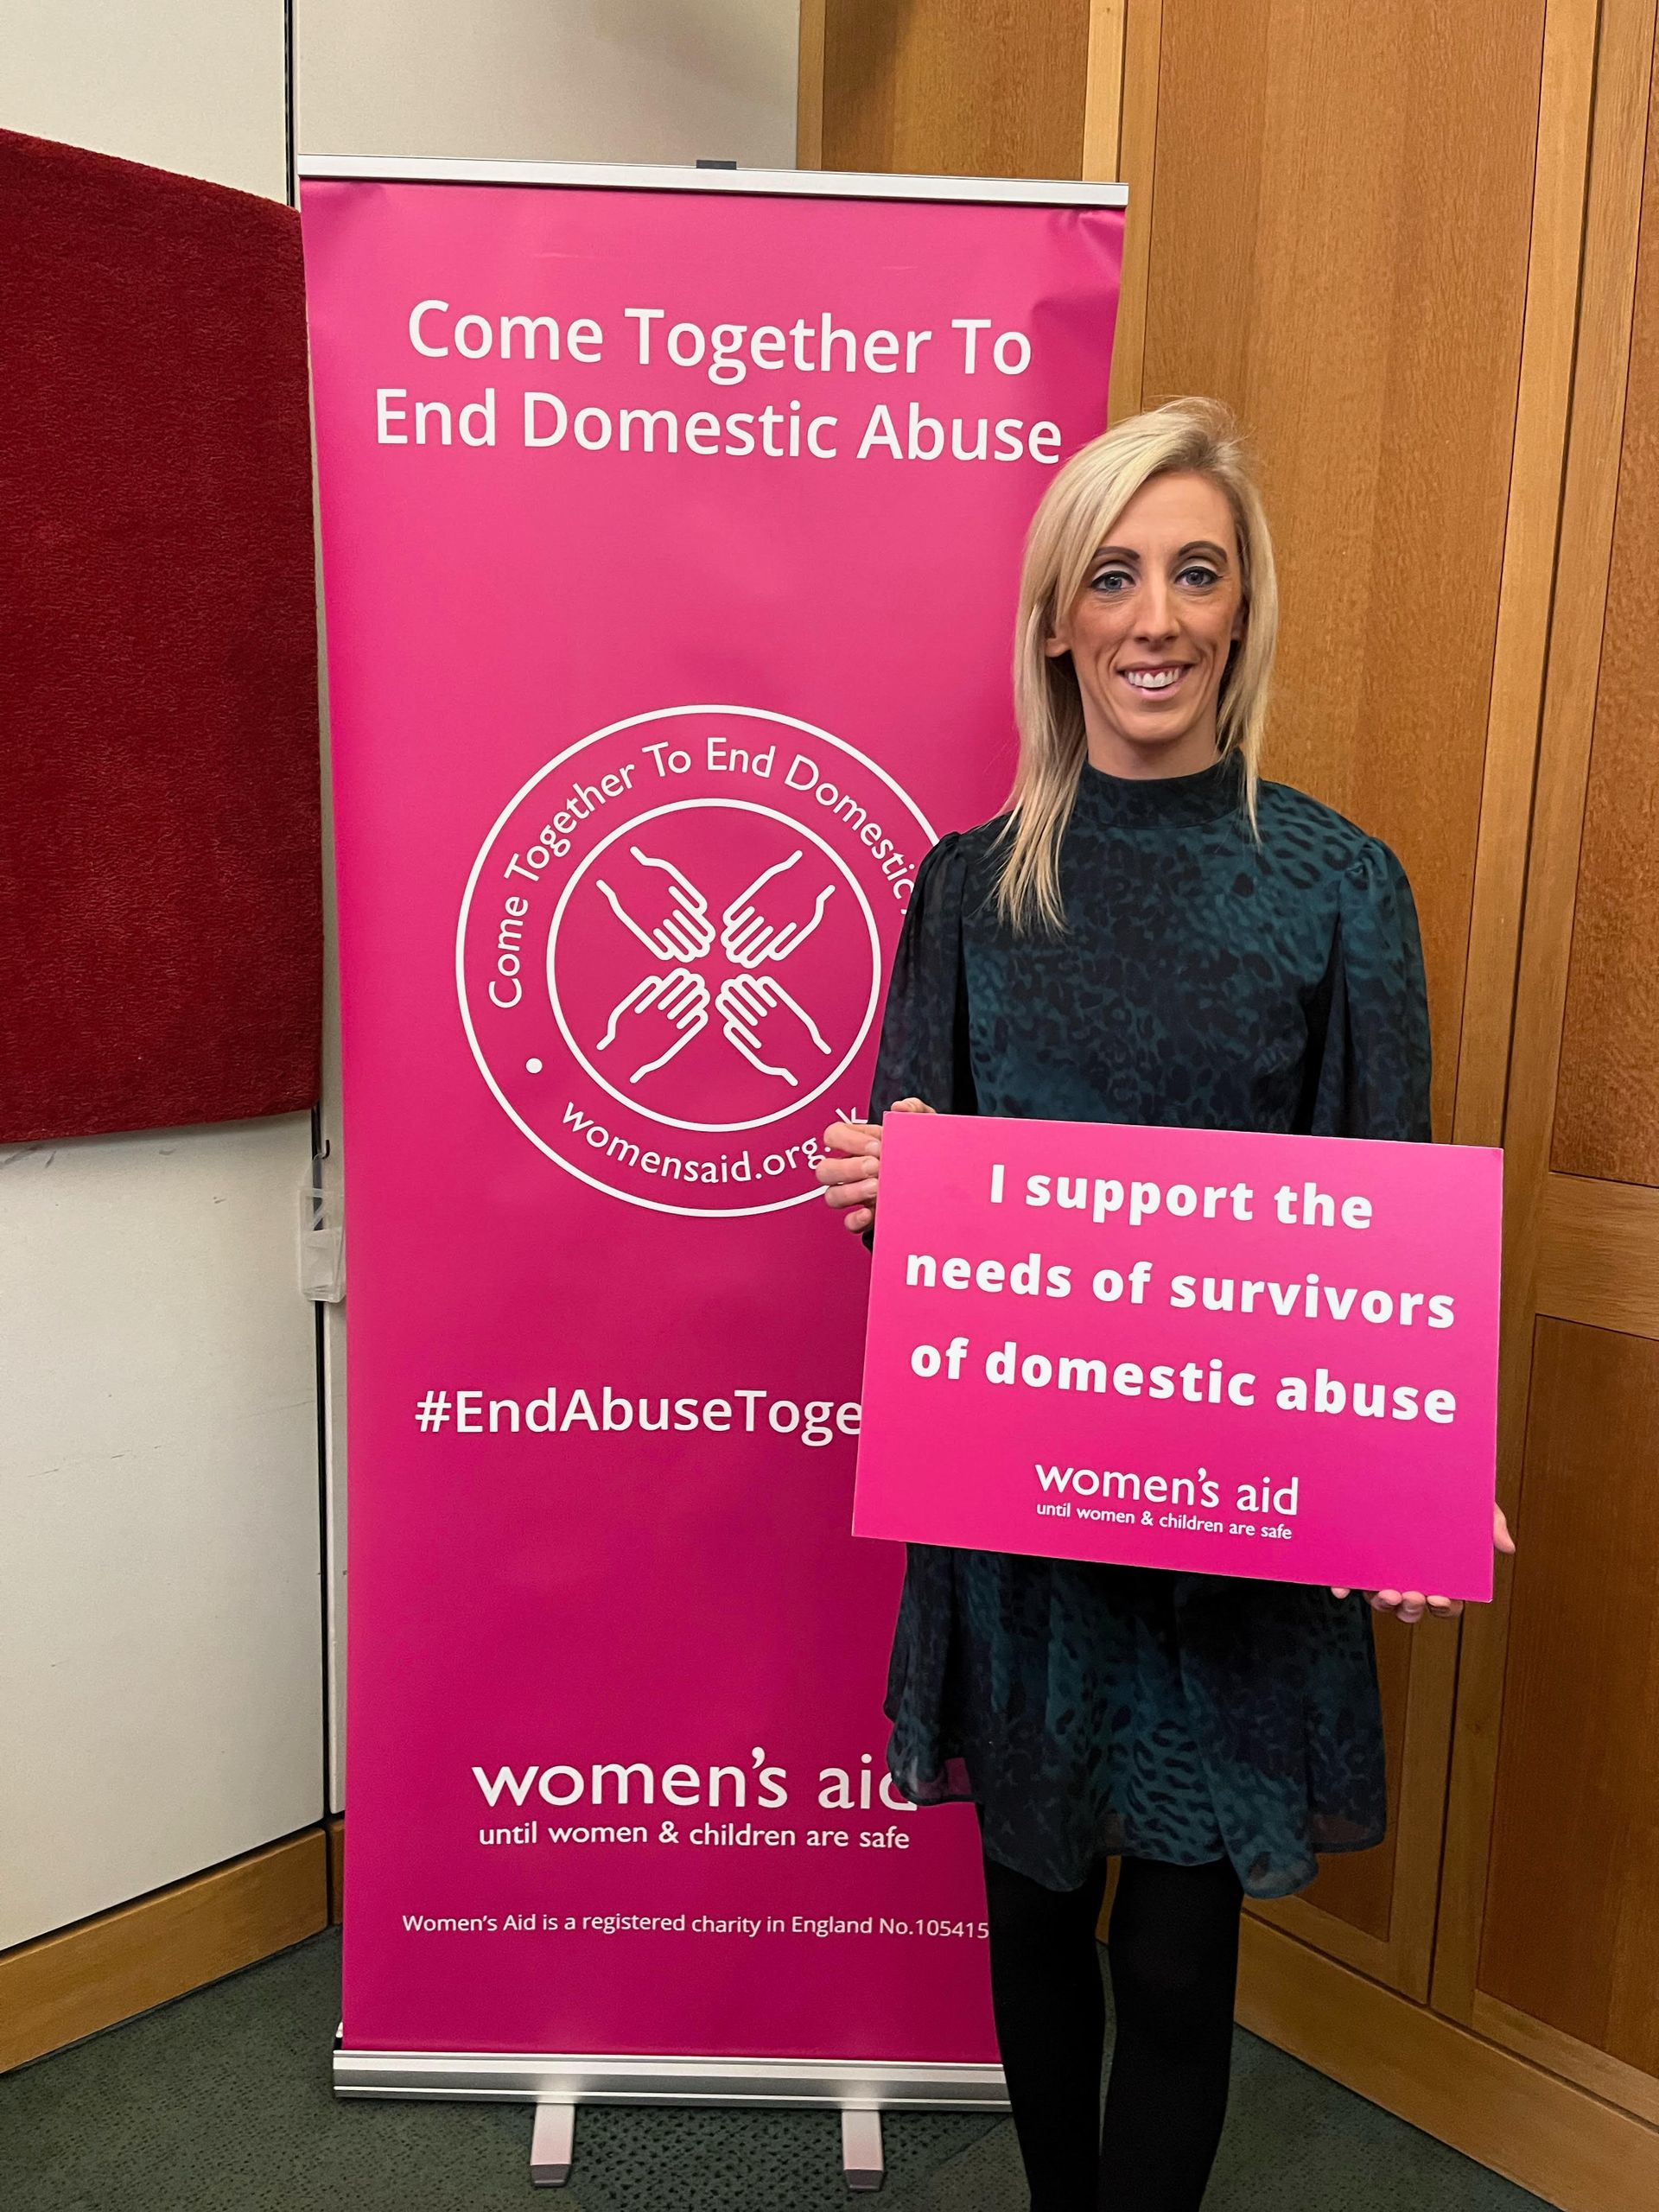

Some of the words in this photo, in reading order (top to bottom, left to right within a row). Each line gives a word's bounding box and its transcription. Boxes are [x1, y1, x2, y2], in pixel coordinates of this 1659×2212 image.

[409, 299, 603, 363] Come
[624, 308, 932, 386] Together
[951, 318, 1032, 375] To
[376, 387, 496, 447] End
[524, 391, 838, 459] Domestic
[856, 401, 1062, 464] Abuse
[641, 741, 691, 778] To
[707, 737, 776, 779] End
[503, 764, 635, 881] Together
[784, 753, 915, 899] Domestic
[488, 896, 529, 1008] Come
[563, 1102, 868, 1184] womensaid.org.k
[990, 1164, 1005, 1204] I
[1026, 1174, 1254, 1226] support
[1274, 1181, 1373, 1230] the
[906, 1252, 1071, 1298] needs
[1092, 1261, 1154, 1304] of
[1170, 1273, 1455, 1329] survivors
[911, 1337, 969, 1380] of
[985, 1341, 1256, 1407] domestic
[1276, 1368, 1456, 1424] abuse
[1034, 1464, 1219, 1508] women's
[1236, 1476, 1299, 1516] aid
[1036, 1503, 1071, 1517] until
[1076, 1508, 1135, 1524] women
[1141, 1510, 1154, 1526] &
[1159, 1512, 1224, 1533] children
[1229, 1523, 1255, 1536] are
[1261, 1523, 1293, 1540] safe
[471, 1746, 788, 1808] women's
[480, 1821, 537, 1845] until
[548, 1827, 647, 1843] women
[658, 1821, 679, 1844] &
[690, 1822, 796, 1847] children
[806, 1830, 849, 1847] are
[859, 1825, 909, 1849] safe
[403, 1914, 499, 1932] Women's
[503, 1914, 536, 1931] Aid
[543, 1914, 558, 1930] is
[564, 1917, 575, 1930] a
[582, 1913, 685, 1935] registered
[691, 1914, 762, 1938] charity
[767, 1916, 785, 1933] in
[792, 1916, 873, 1937] England
